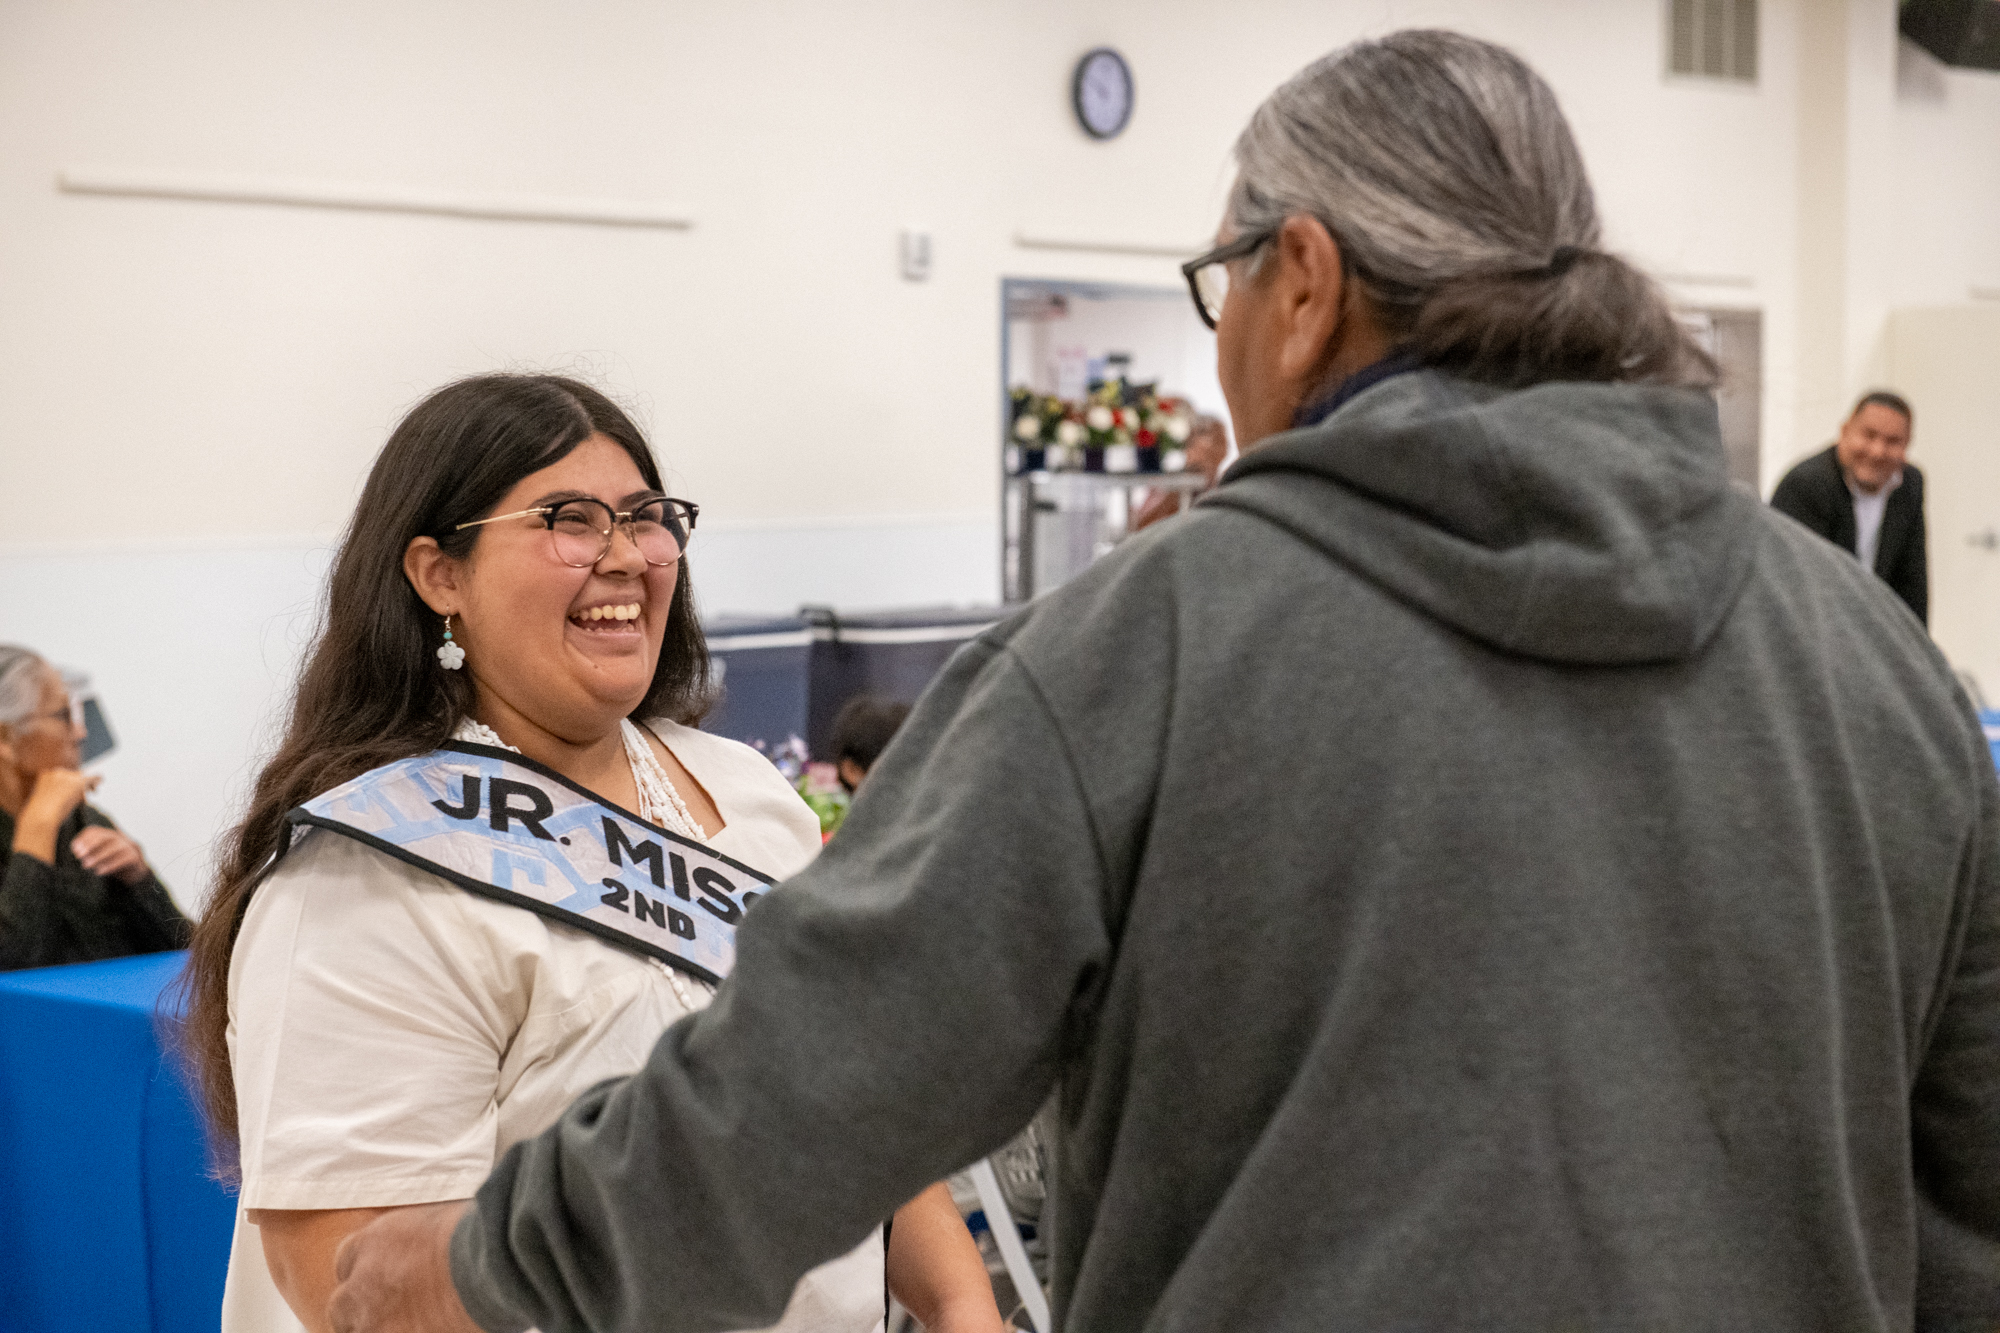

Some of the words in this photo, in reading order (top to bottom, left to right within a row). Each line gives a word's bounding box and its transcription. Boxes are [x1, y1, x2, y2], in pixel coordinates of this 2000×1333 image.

[431, 774, 571, 846] JR.
[601, 815, 764, 926] MIS
[601, 878, 696, 941] 2ND
